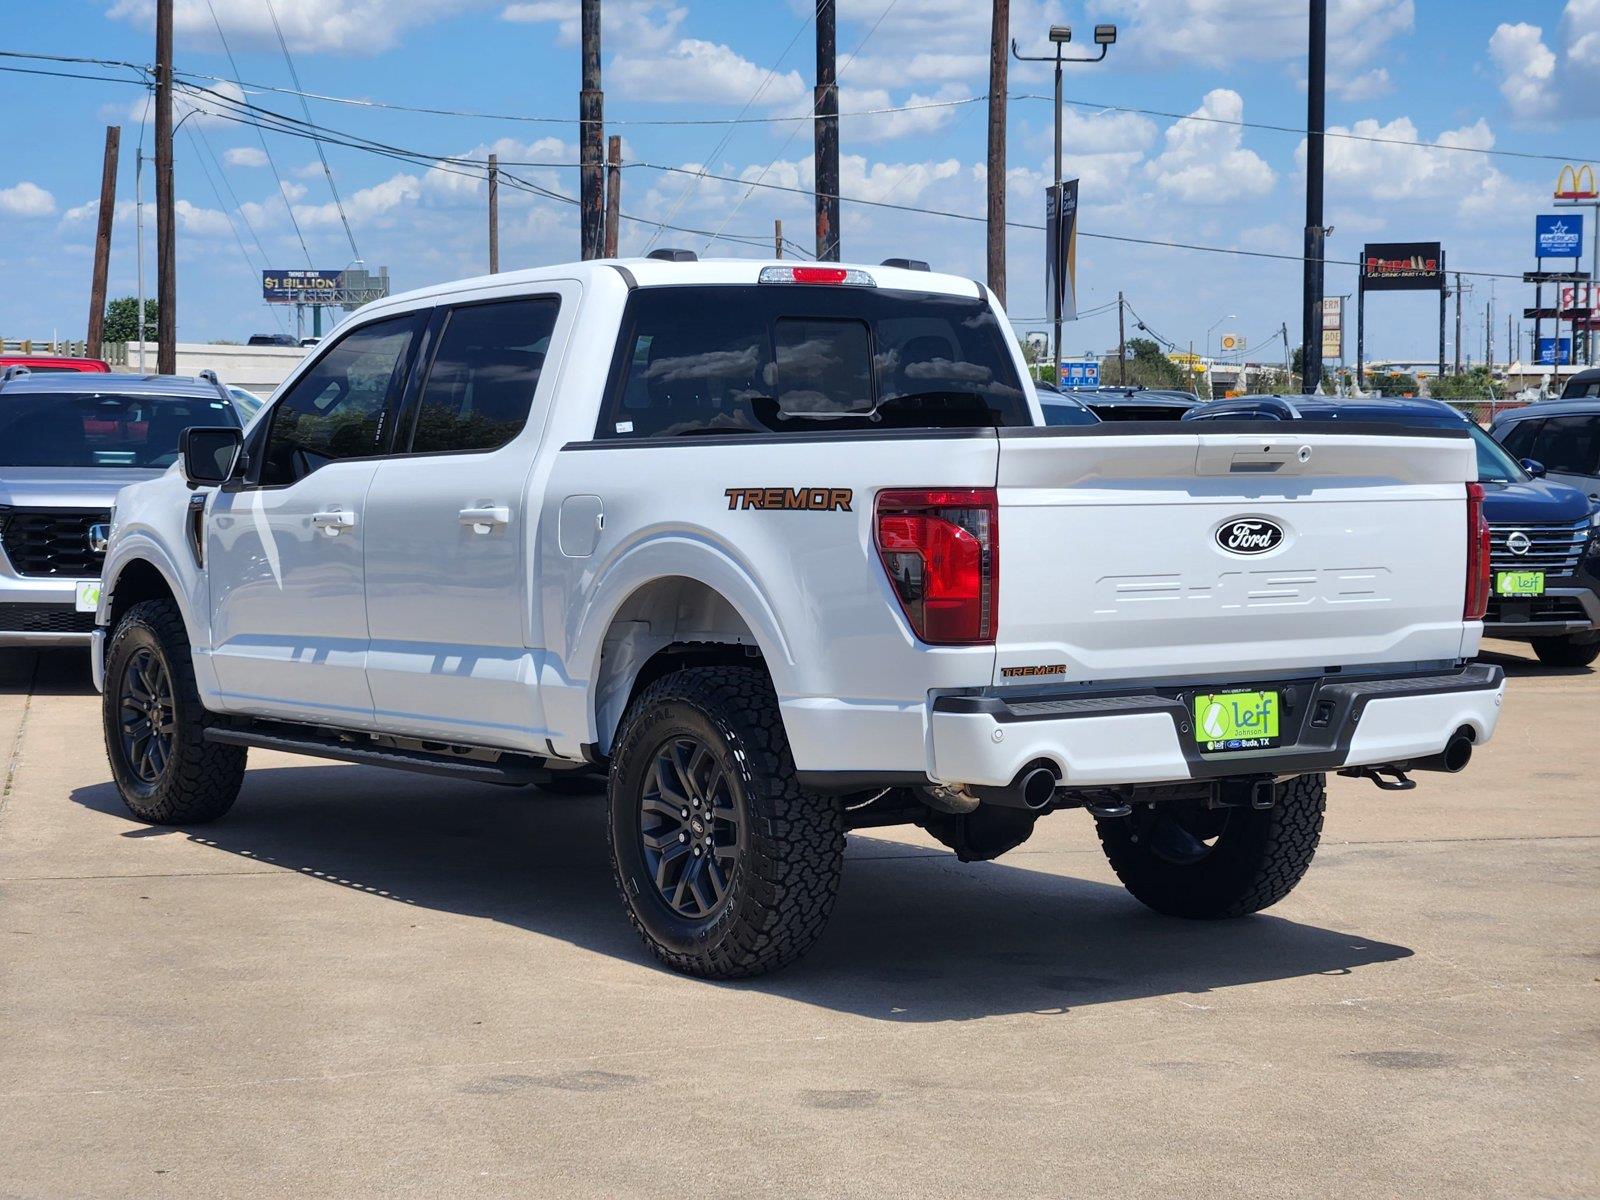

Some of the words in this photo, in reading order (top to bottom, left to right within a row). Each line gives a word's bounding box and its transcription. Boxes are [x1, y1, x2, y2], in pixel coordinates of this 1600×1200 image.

[283, 278, 336, 289] BILLION
[724, 487, 853, 512] TREMOR
[1227, 521, 1273, 549] Ford
[1001, 664, 1067, 678] TREMOR
[1234, 729, 1262, 737] Johnson
[1241, 739, 1259, 748] Buda,
[1259, 738, 1270, 746] TX
